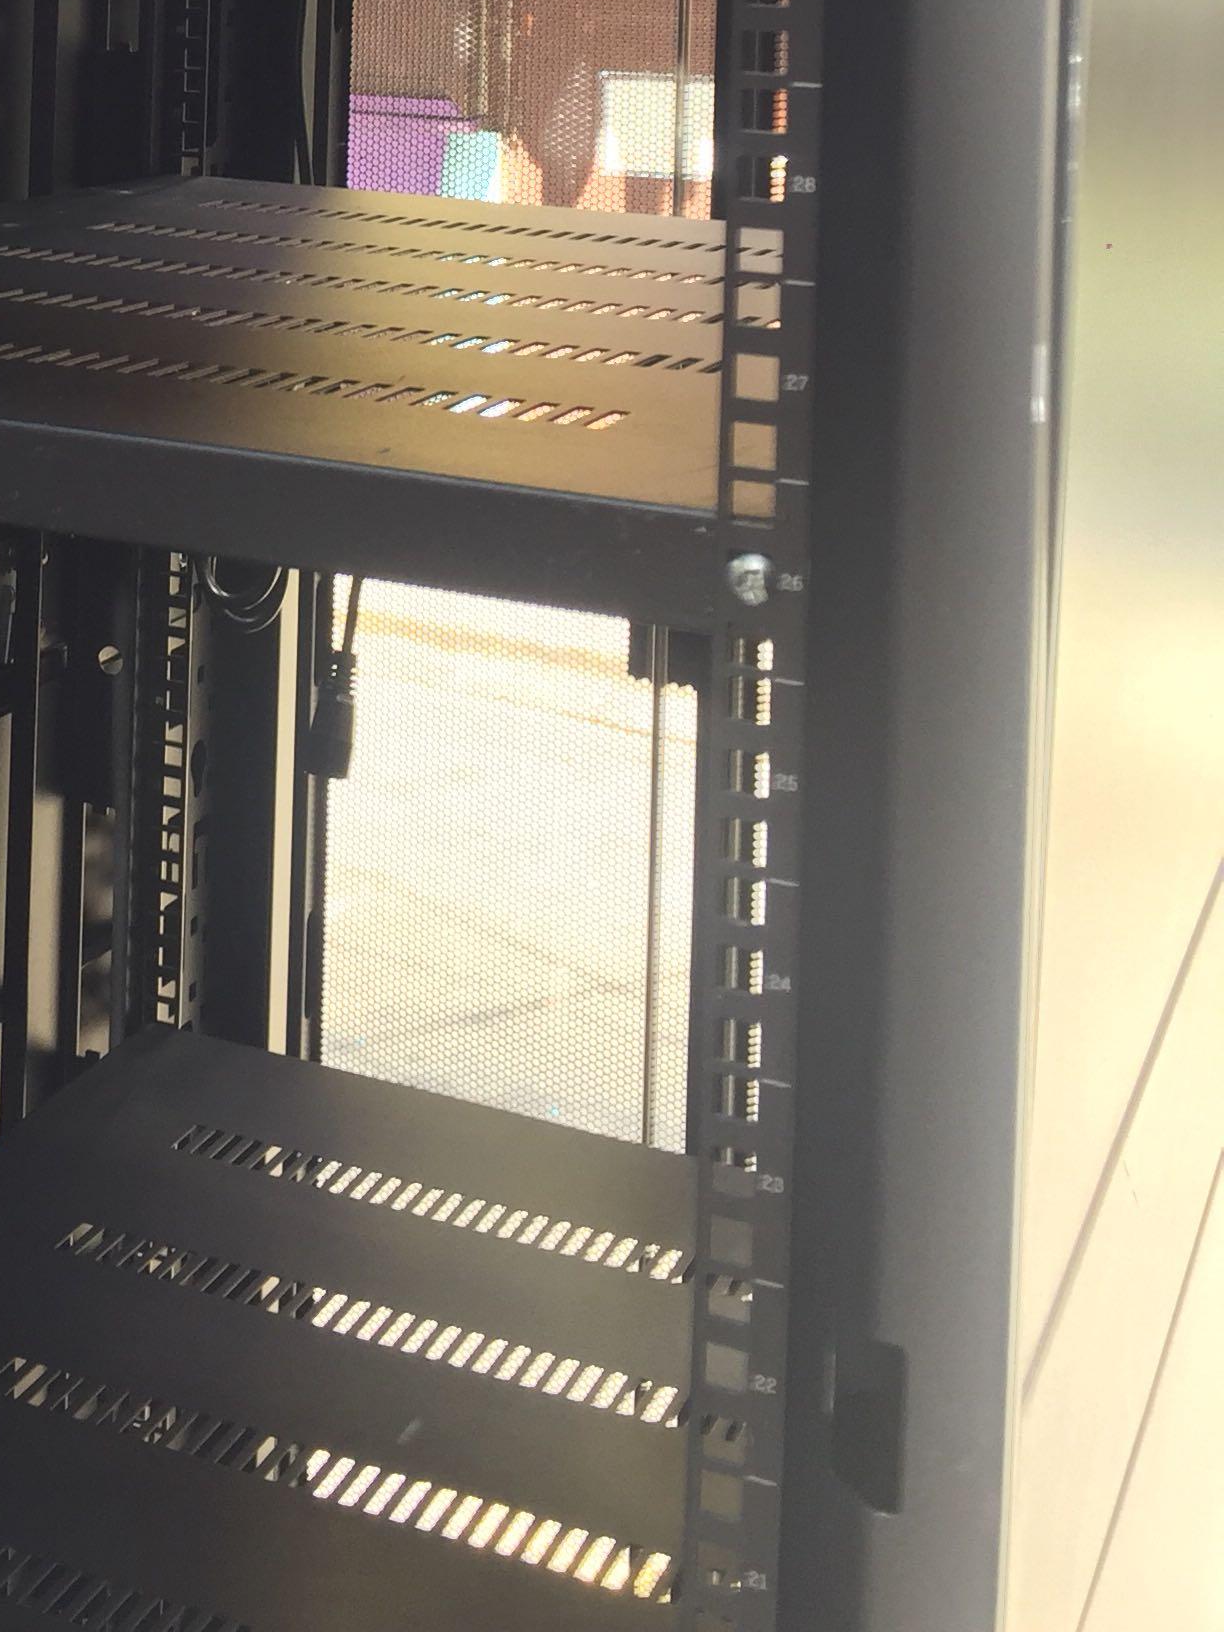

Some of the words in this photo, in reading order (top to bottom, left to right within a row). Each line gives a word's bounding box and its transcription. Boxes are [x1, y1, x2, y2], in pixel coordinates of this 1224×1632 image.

[793, 175, 817, 193] 28
[785, 374, 809, 392] 27
[775, 774, 799, 792] 25
[769, 975, 792, 993] 24
[760, 1175, 785, 1194] 23
[753, 1374, 777, 1394] 22
